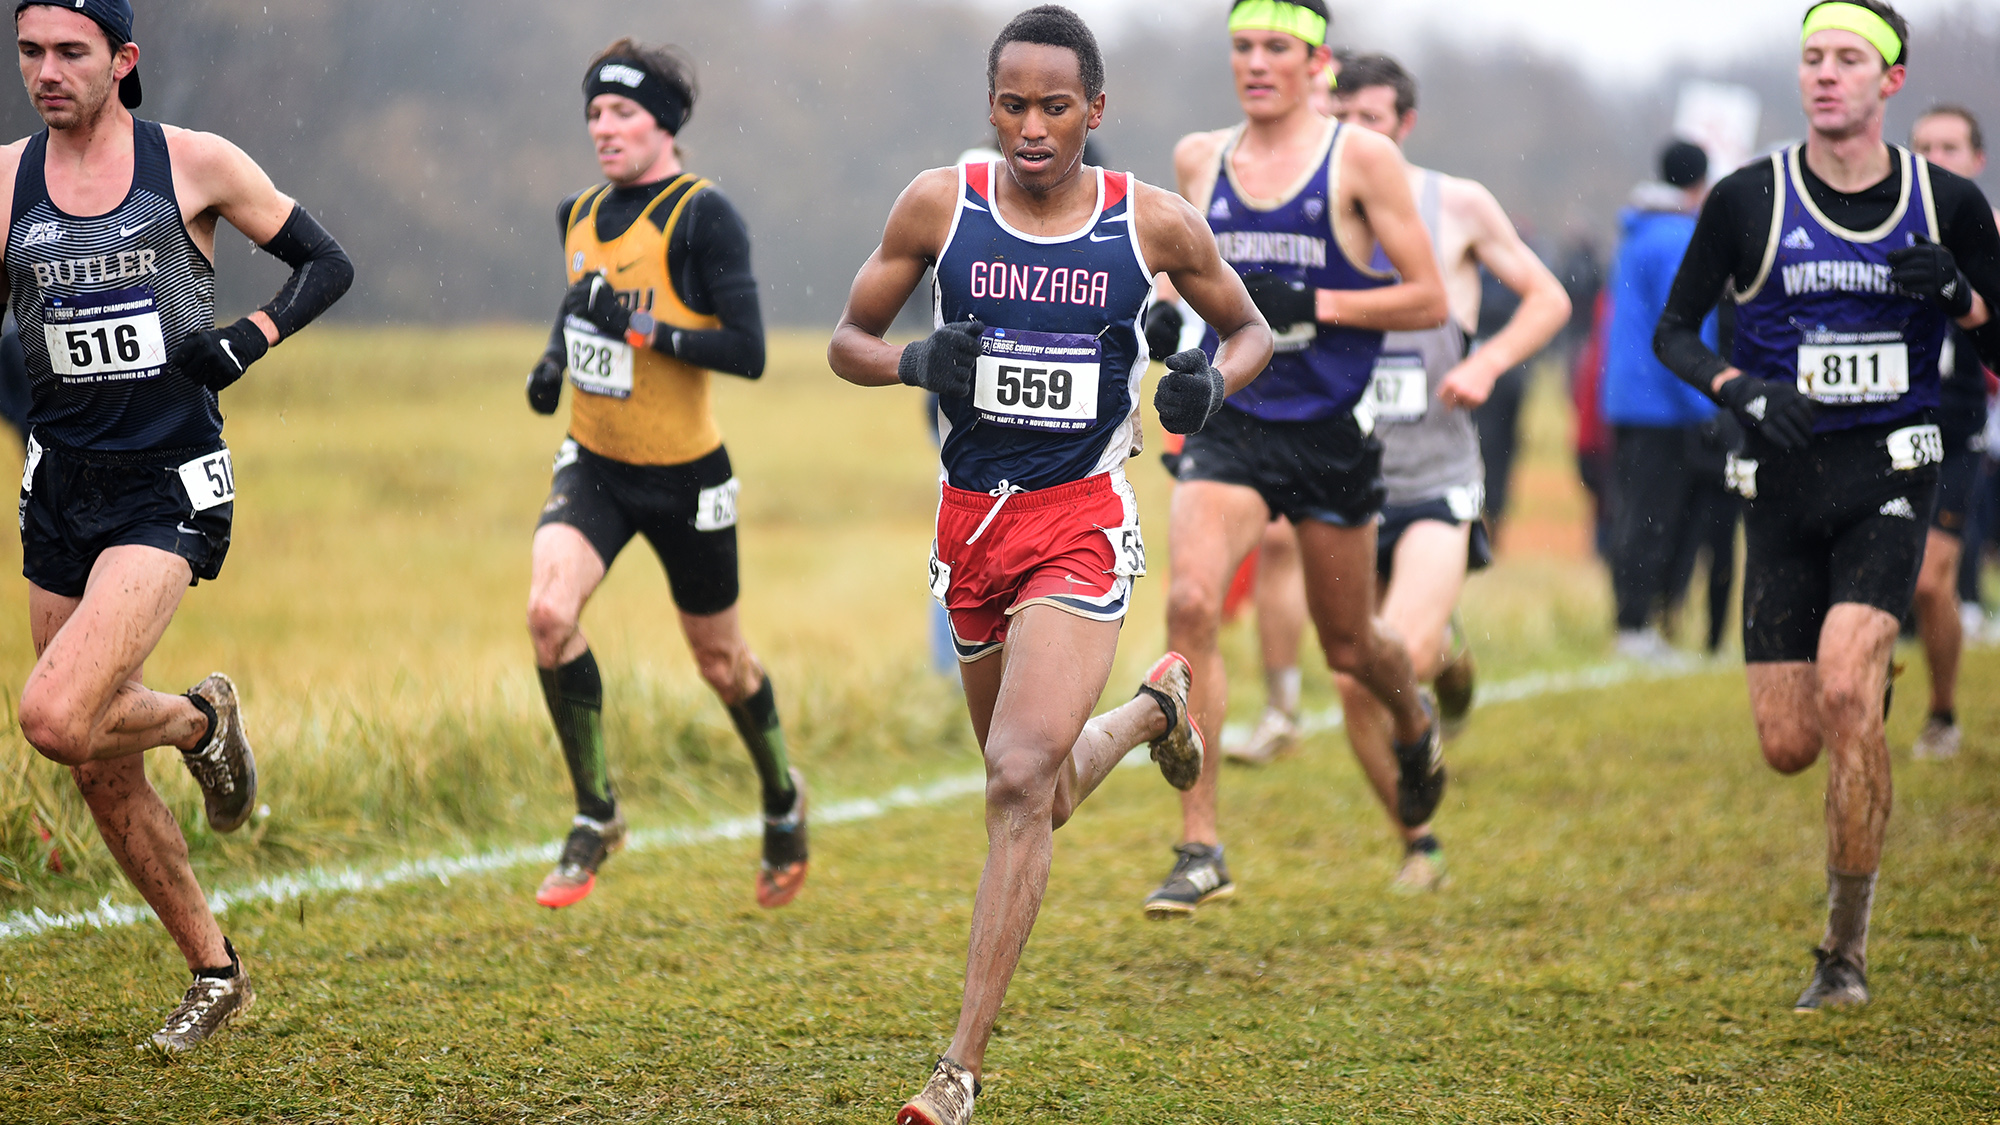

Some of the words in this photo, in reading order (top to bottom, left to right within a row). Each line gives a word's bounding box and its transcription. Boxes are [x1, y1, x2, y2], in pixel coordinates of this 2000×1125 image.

[30, 222, 59, 232] BIG
[31, 249, 158, 288] BUTLER
[970, 261, 1109, 307] GONZAGA
[1781, 260, 1925, 300] WASHING
[54, 310, 74, 319] CROSS
[103, 298, 153, 314] CHAMPIONSHIPS
[65, 324, 141, 368] 516
[573, 341, 612, 377] 628
[992, 342, 1014, 351] CROSS
[1014, 344, 1045, 354] COUNTRY
[1044, 346, 1097, 356] CHAMPIONSHIPS
[996, 365, 1073, 410] 559
[1823, 353, 1878, 385] 811
[1029, 419, 1060, 428] NOVEMBER
[203, 453, 234, 498] 51
